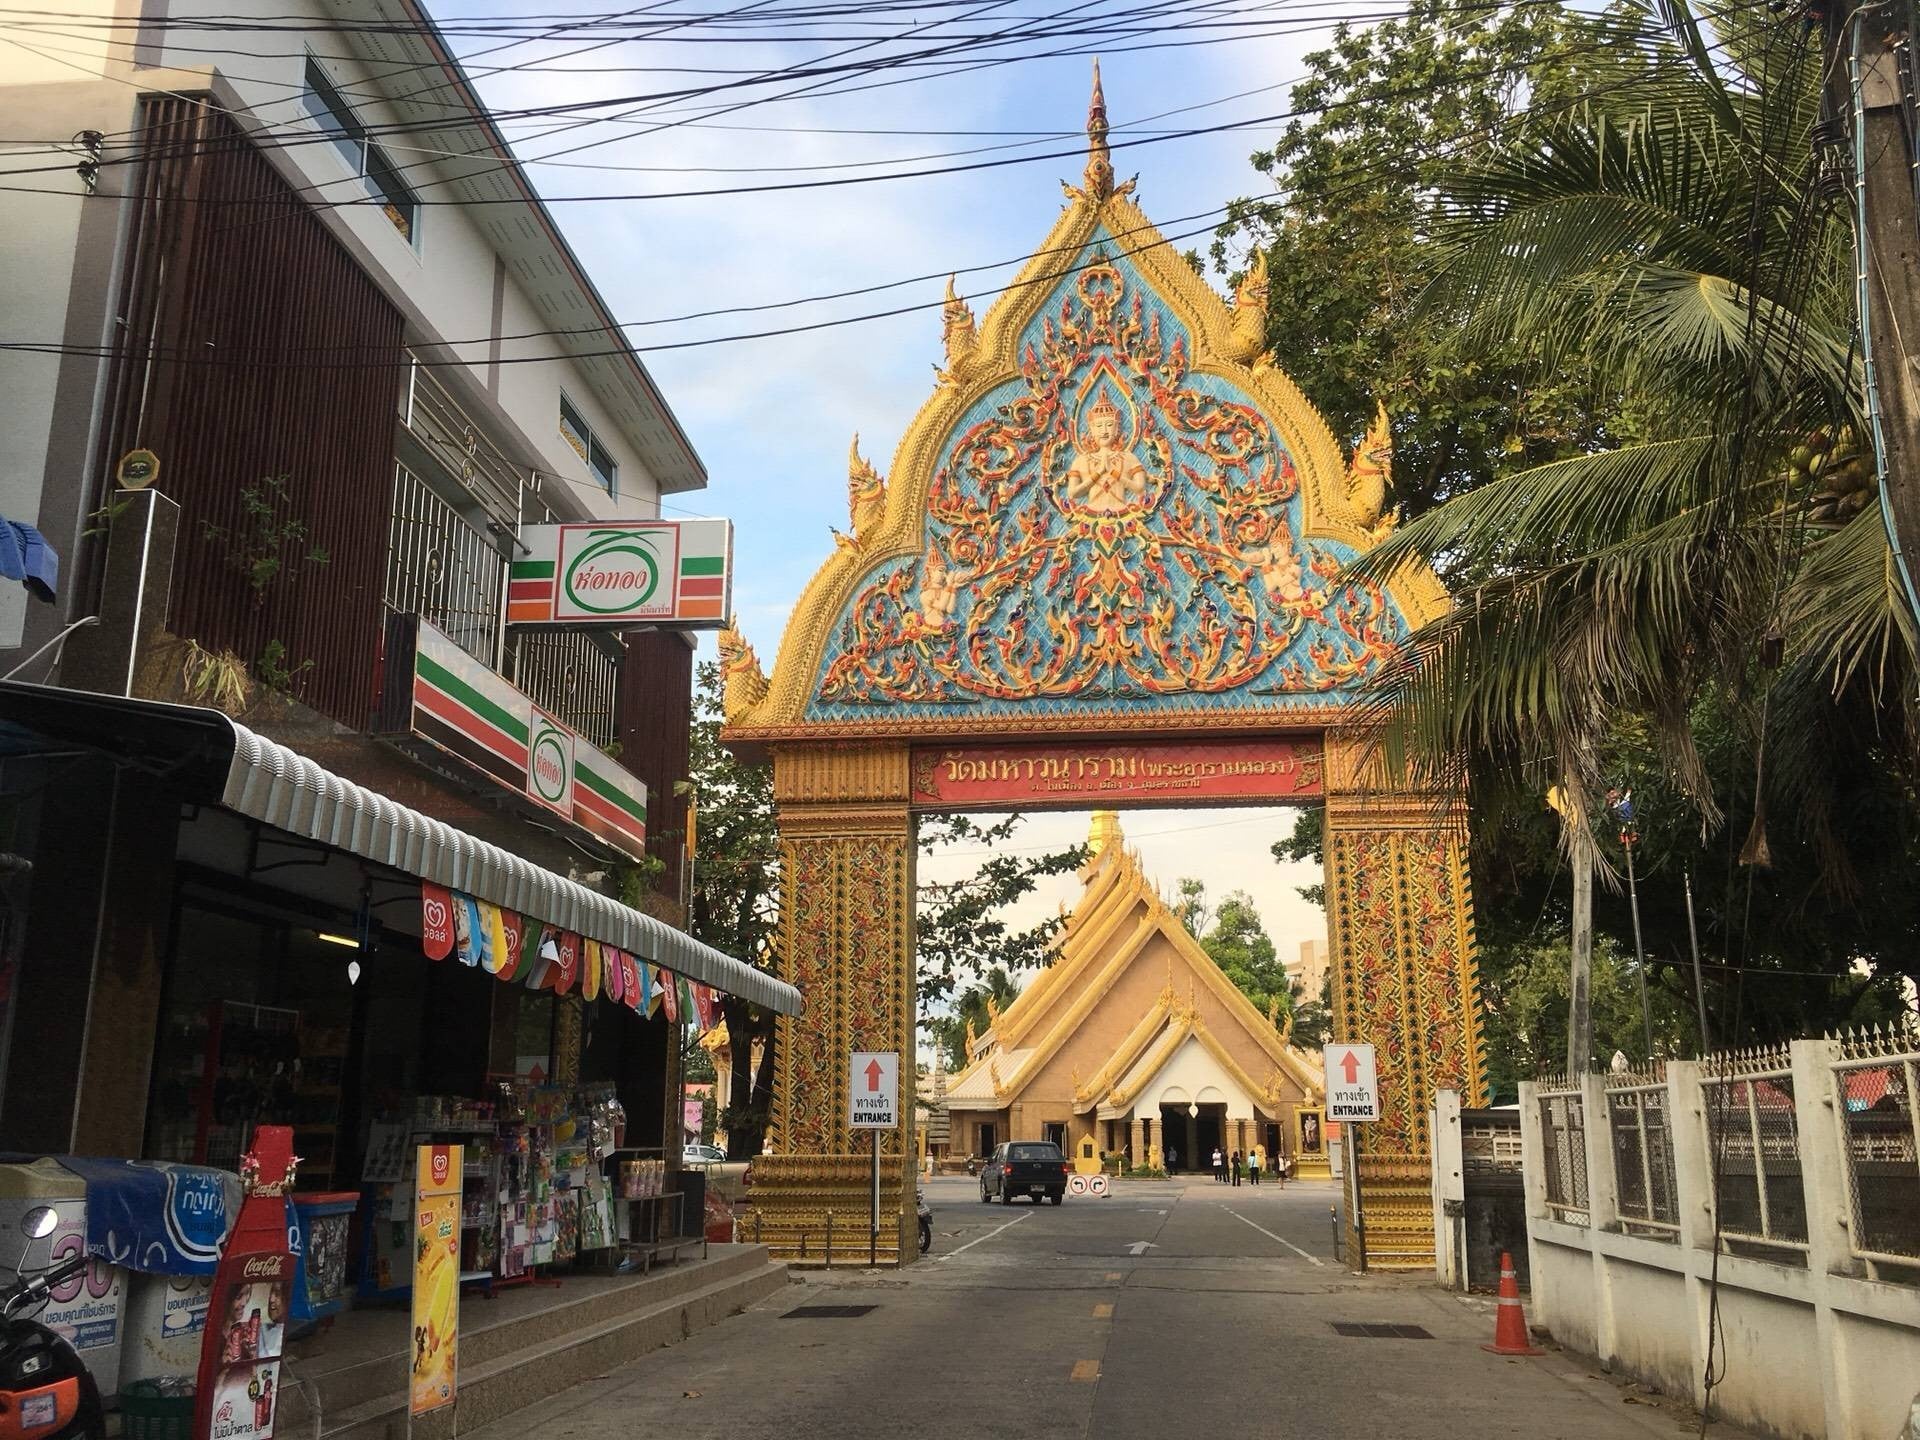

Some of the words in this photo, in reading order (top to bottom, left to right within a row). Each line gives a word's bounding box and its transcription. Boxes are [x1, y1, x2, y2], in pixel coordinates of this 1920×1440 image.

[575, 566, 648, 591] ห่อทอง
[536, 747, 562, 786] ห่อทอง
[942, 752, 1137, 781] วัดมหาวนาราม
[855, 1093, 889, 1108] ทางเข้า
[1335, 1087, 1370, 1101] ทางเข้า
[854, 1113, 892, 1123] ENTRANCE
[1333, 1106, 1374, 1116] ENTRANCE
[243, 1255, 285, 1278] Coca-Cola
